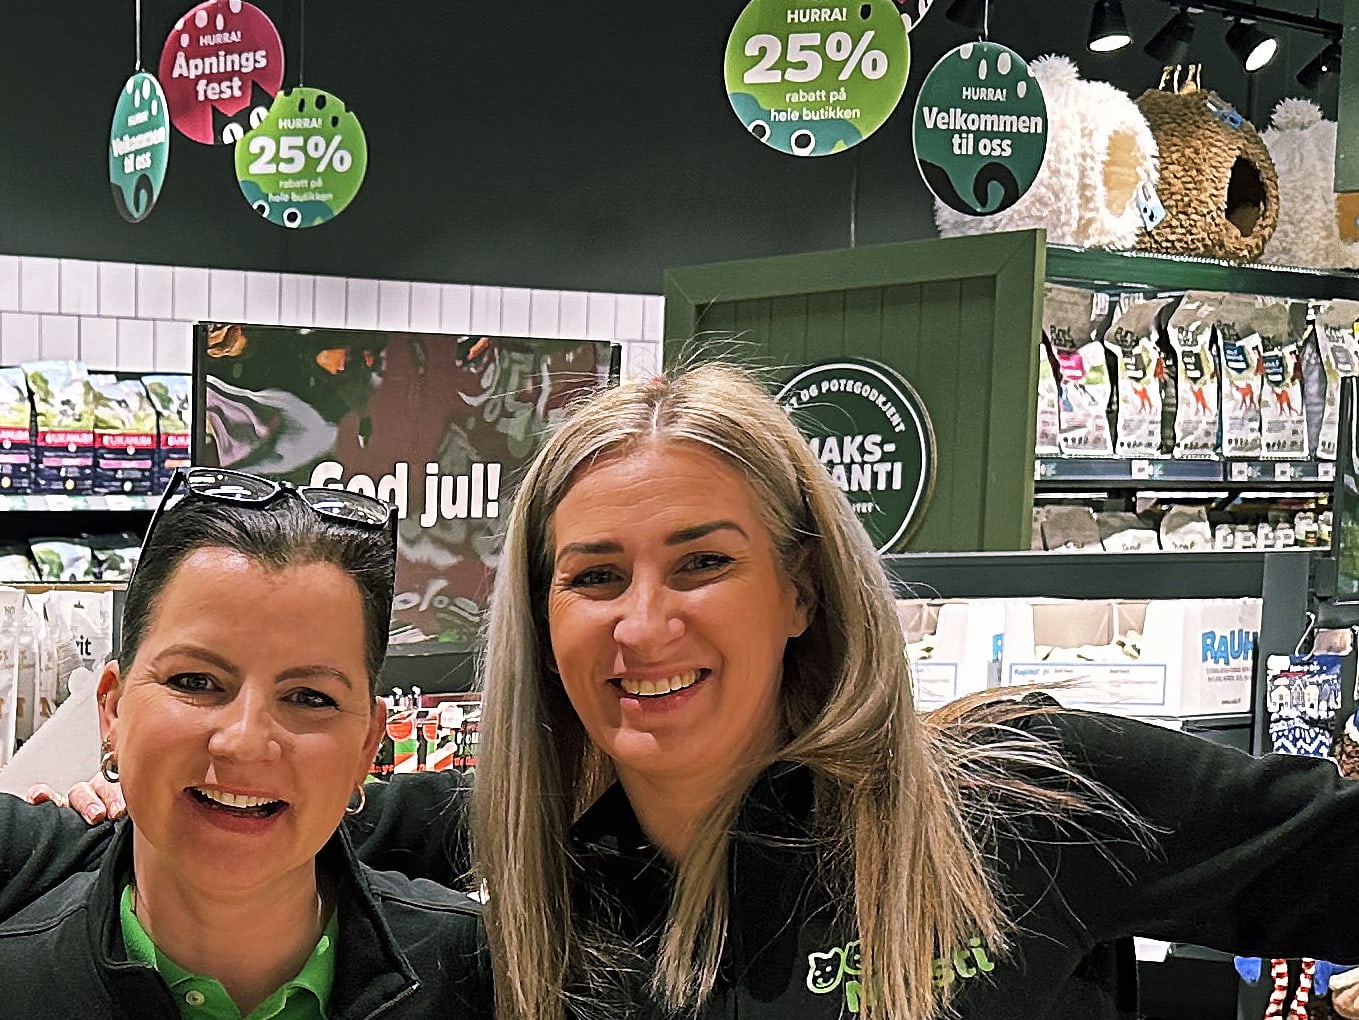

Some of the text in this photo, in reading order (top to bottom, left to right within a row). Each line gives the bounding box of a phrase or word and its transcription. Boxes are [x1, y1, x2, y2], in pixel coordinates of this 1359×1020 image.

[787, 8, 848, 24] HURRA!
[199, 30, 242, 47] HURRA!
[172, 49, 268, 79] Åpnings
[743, 30, 888, 85] 25%
[197, 76, 243, 101] fest
[785, 89, 847, 106] rabatt på
[962, 86, 1007, 102] HURRA!
[278, 117, 323, 130] HURRA!
[770, 107, 861, 122] hele butikken
[923, 106, 1043, 134] Velkommen
[248, 134, 353, 175] 25%
[952, 132, 1013, 157] til oss
[278, 178, 324, 191] rabatt på
[419, 462, 502, 529] jul!
